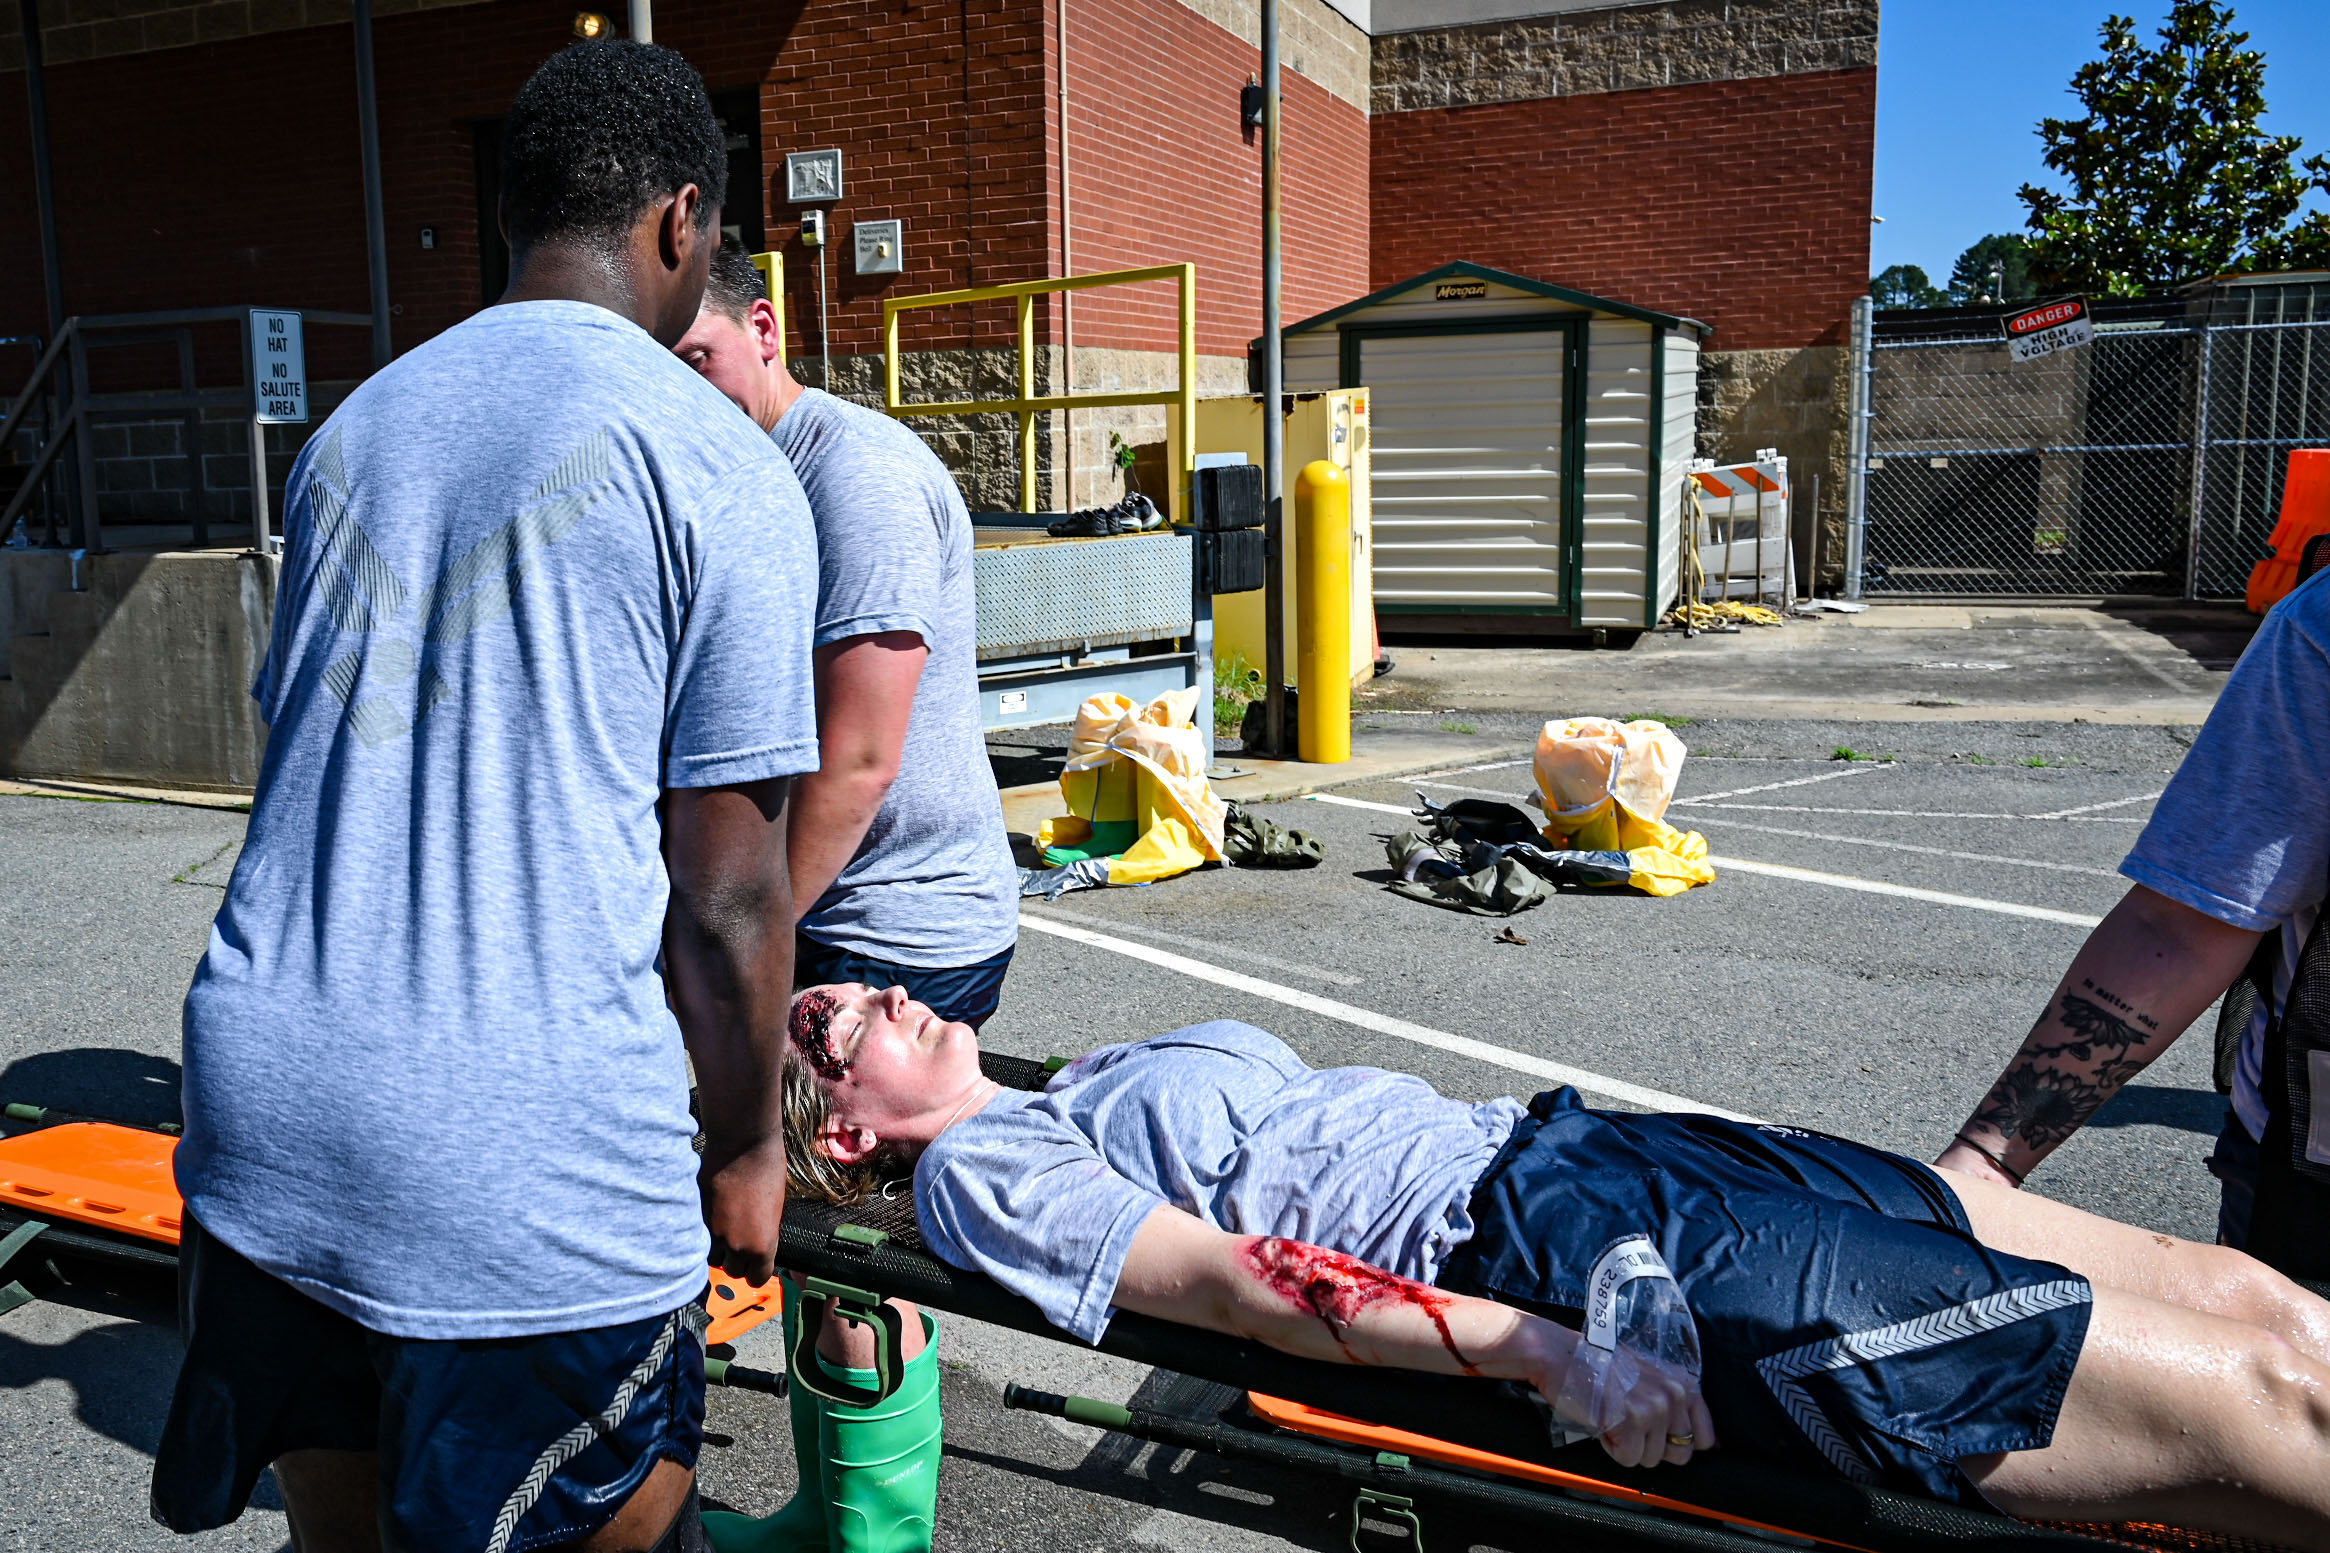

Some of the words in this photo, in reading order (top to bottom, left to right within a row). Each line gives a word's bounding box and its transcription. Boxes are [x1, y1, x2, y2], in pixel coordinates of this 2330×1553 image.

[1437, 286, 1485, 298] Morgan
[268, 318, 284, 333] NO
[2016, 304, 2074, 331] DANGER
[2031, 327, 2069, 345] HIGH
[267, 337, 288, 352] HAT
[2020, 331, 2085, 358] VOLTAGE
[272, 363, 287, 378] NO
[260, 381, 301, 397] SALUTE
[268, 400, 296, 416] AREA
[2095, 987, 2134, 1013] matter
[2137, 1012, 2159, 1031] what
[1593, 1268, 1618, 1329] 238759
